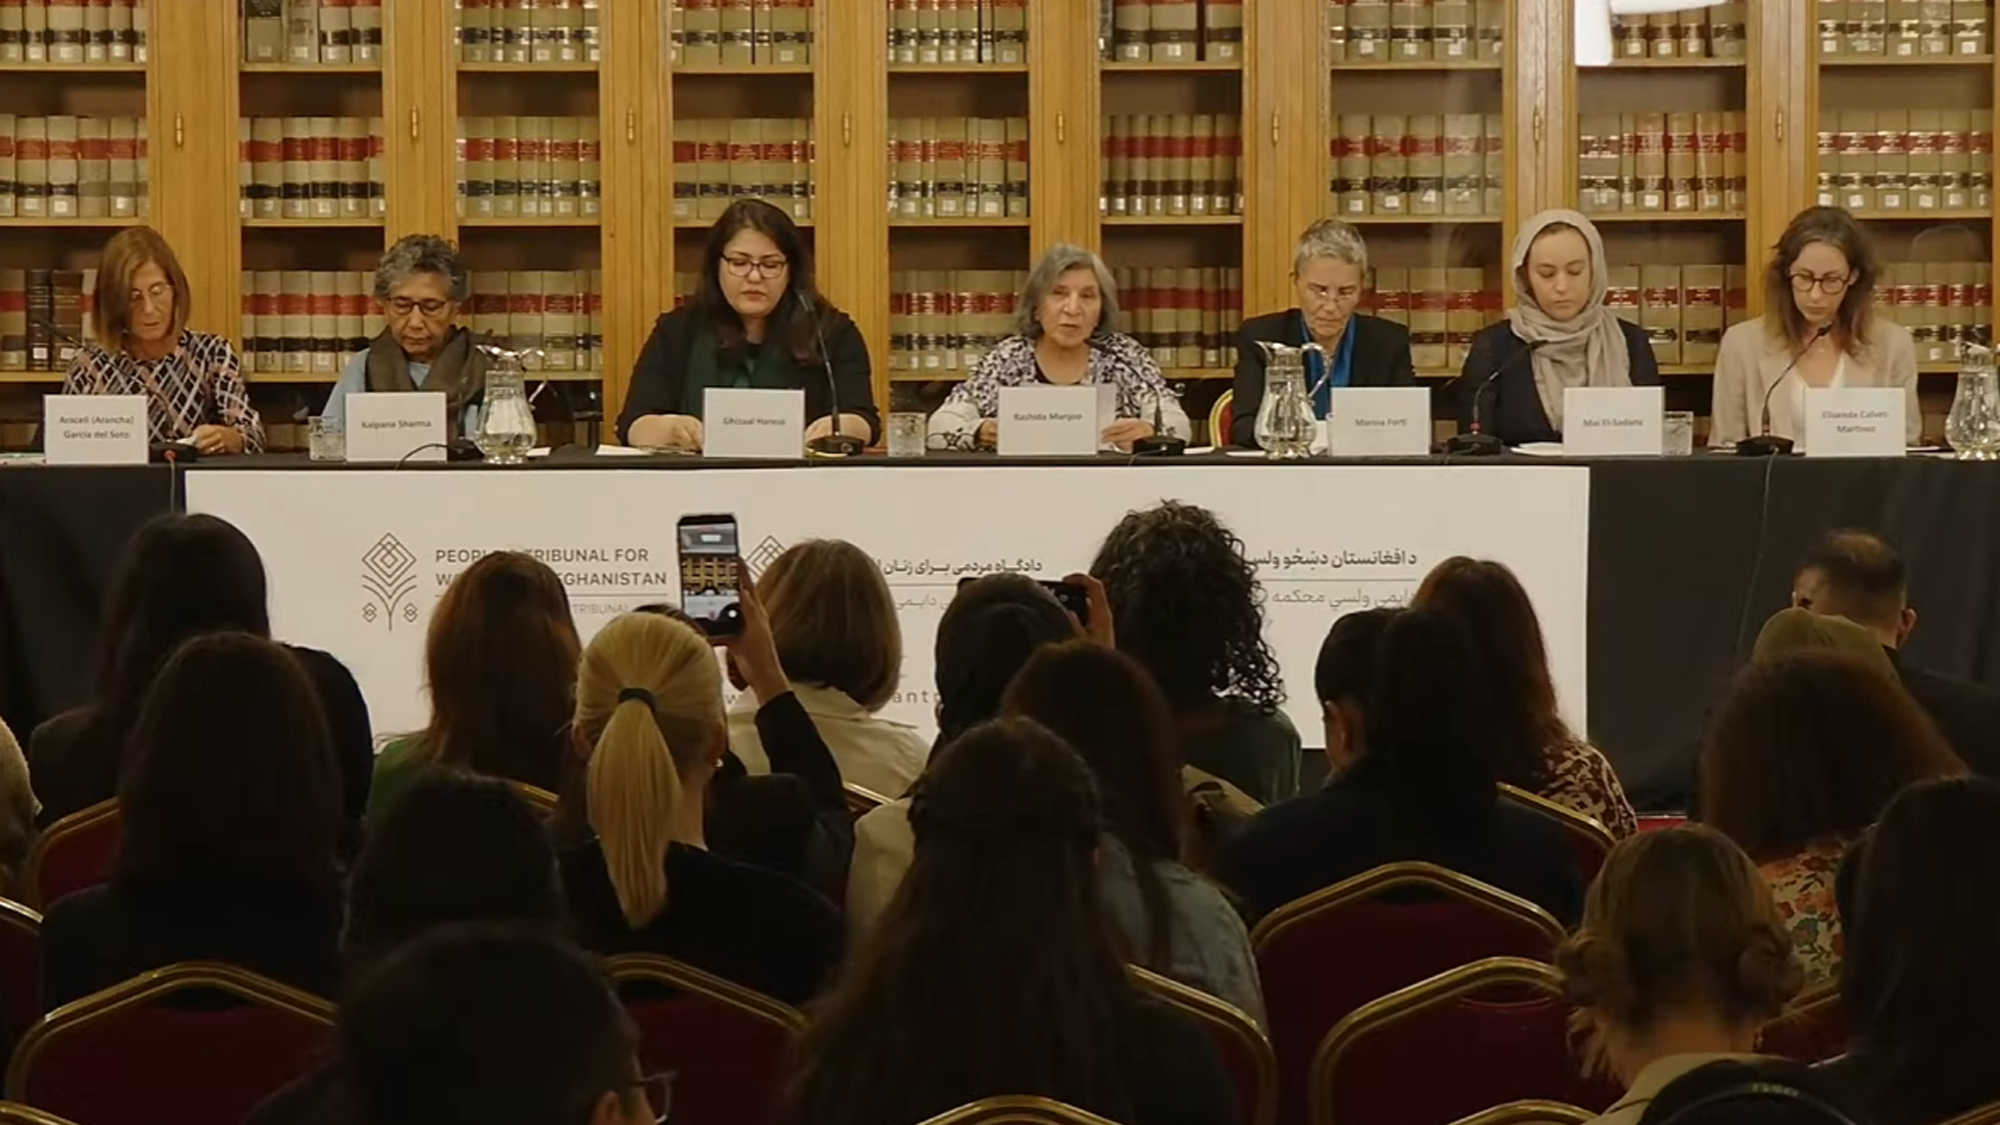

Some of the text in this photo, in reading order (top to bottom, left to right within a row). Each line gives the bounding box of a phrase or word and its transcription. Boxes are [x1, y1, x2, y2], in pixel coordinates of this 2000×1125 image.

[361, 419, 432, 430] Kalpana Sharma
[1354, 418, 1408, 427] Marina Forti
[1583, 418, 1600, 427] Mai
[94, 430, 108, 439] del
[110, 430, 130, 439] Soto
[614, 548, 650, 562] FOR
[1331, 547, 1406, 569] افغانستان
[556, 572, 668, 586] GHANISTAN
